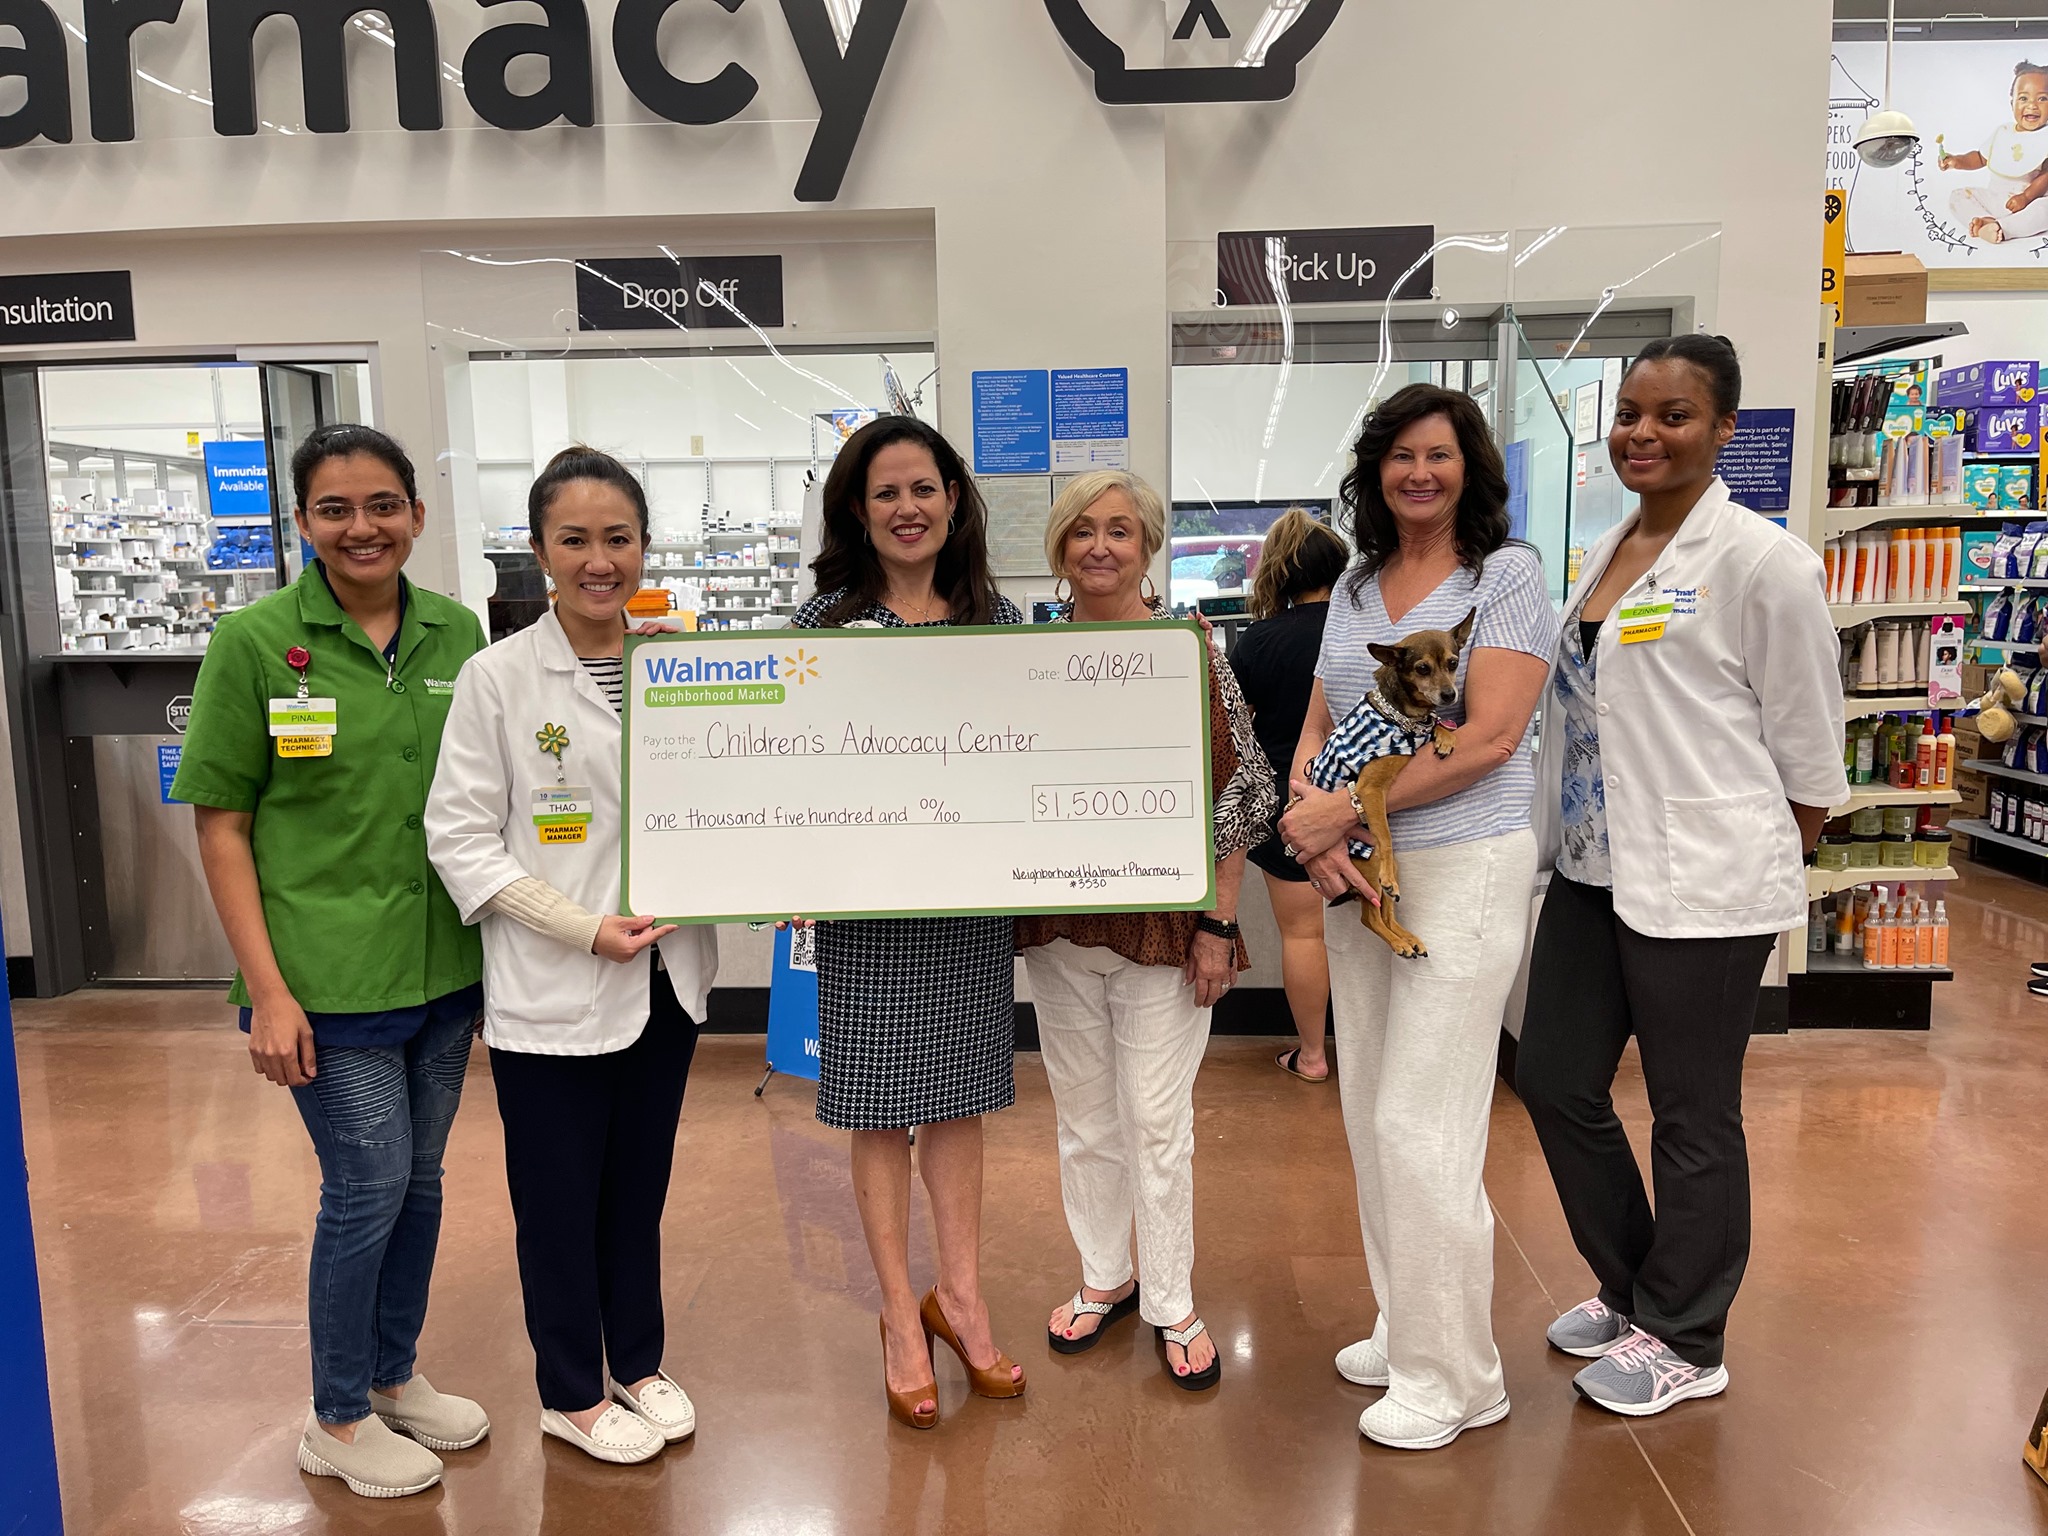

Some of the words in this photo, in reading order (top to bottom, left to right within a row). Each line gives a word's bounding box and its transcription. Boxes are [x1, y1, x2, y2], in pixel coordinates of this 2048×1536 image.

[1827, 125, 1851, 144] PERS
[1826, 151, 1856, 170] FOOD
[1277, 252, 1329, 281] Pick
[1336, 252, 1376, 286] Up
[622, 282, 689, 314] Drop
[695, 278, 739, 307] Off
[1993, 369, 2028, 392] Luvs
[1990, 415, 2024, 438] Luvs
[213, 465, 268, 478] Immuniza
[218, 480, 264, 492] Available
[1632, 606, 1661, 616] EZINNE
[1623, 625, 1662, 636] PHARMACIST
[645, 654, 779, 684] Walmart
[1028, 669, 1060, 681] Date:
[1067, 651, 1154, 687] 06/18/21
[650, 688, 734, 704] Neighborhood
[738, 687, 779, 701] Market
[291, 714, 318, 723] PINAL
[282, 736, 326, 745] PHARMACY
[643, 735, 661, 748] Pay
[663, 736, 675, 746] to
[678, 734, 696, 746] the
[706, 721, 825, 759] Children's
[840, 721, 947, 767] Advocacy
[958, 721, 1039, 754] Center
[280, 743, 328, 752] TECHNICIAN
[650, 750, 680, 761] order
[549, 803, 577, 813] THAO
[1037, 789, 1176, 819] $1,500.00
[645, 811, 678, 830] one
[685, 807, 766, 829] thousand
[773, 806, 805, 826] five
[808, 806, 874, 825] hundred
[878, 806, 908, 824] and
[544, 826, 583, 834] PHARMACY
[547, 833, 582, 841] MANAGER
[1069, 879, 1107, 889] #3530
